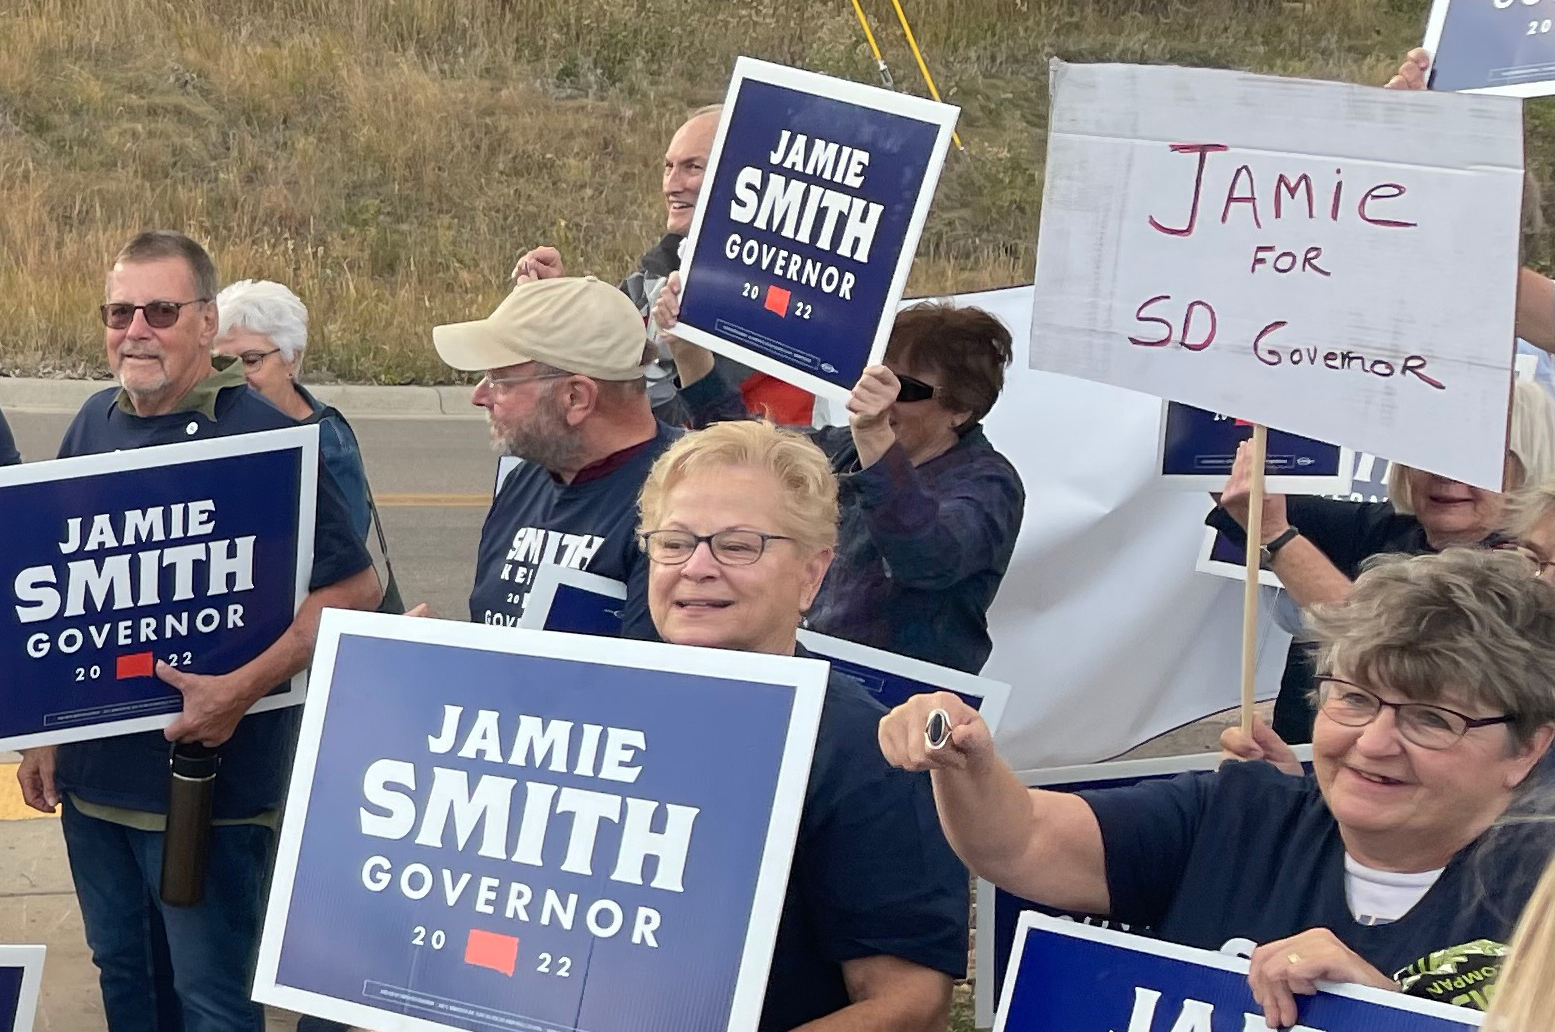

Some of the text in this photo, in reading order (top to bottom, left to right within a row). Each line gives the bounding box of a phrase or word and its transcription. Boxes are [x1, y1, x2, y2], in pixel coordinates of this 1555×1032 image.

[1525, 19, 1552, 36] 20
[770, 129, 870, 189] JAMIE
[729, 166, 884, 263] SMITH
[725, 233, 856, 300] GOVERNOR
[1251, 245, 1331, 276] FOR
[742, 282, 812, 320] 20 22
[1127, 295, 1217, 351] SD
[58, 499, 216, 555] JAMIE
[505, 526, 605, 571] SMITH
[14, 535, 257, 623] SMITH
[507, 592, 520, 604] 20
[26, 603, 245, 659] GOVERNOR
[75, 651, 192, 681] 20 22
[427, 703, 647, 784] JAMIE
[359, 757, 701, 893] SMITH
[360, 855, 662, 949] GOVERNOR
[412, 926, 572, 979] 20 22
